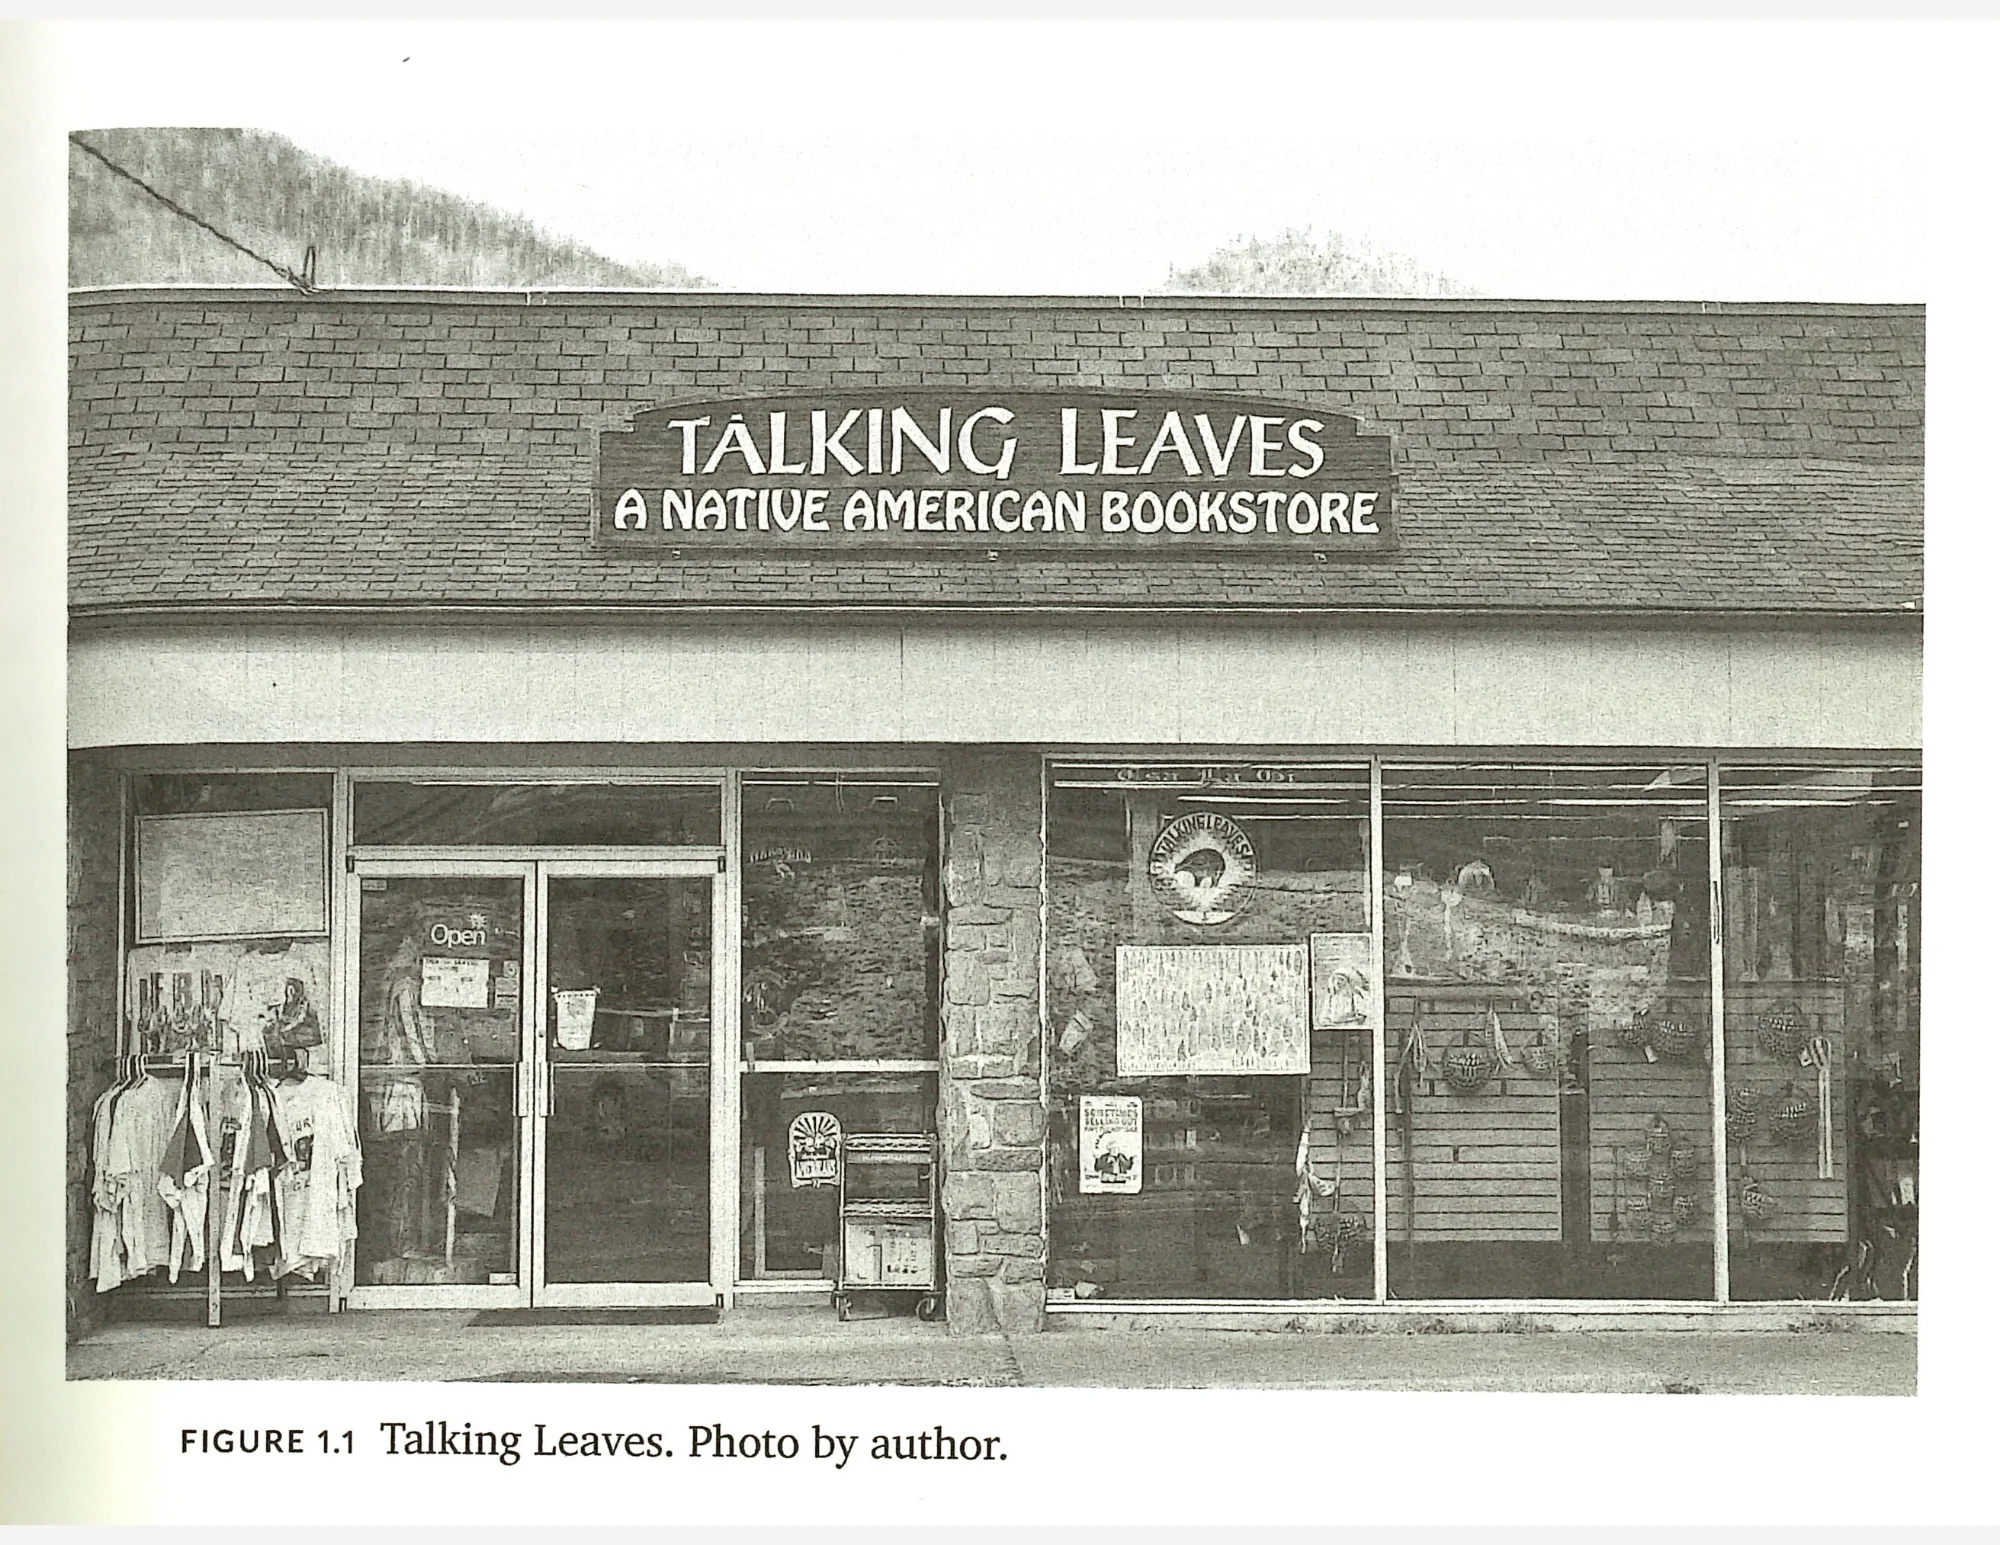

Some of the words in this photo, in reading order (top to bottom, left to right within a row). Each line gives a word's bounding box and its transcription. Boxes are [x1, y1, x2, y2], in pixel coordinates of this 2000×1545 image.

[668, 406, 1017, 479] TALKING
[1060, 408, 1325, 478] LEAVES
[614, 488, 647, 530] A
[663, 488, 830, 531] NATIVE
[843, 489, 1085, 532] AMERICAN
[1102, 490, 1379, 534] BOOKSTORE
[430, 923, 486, 949] Open
